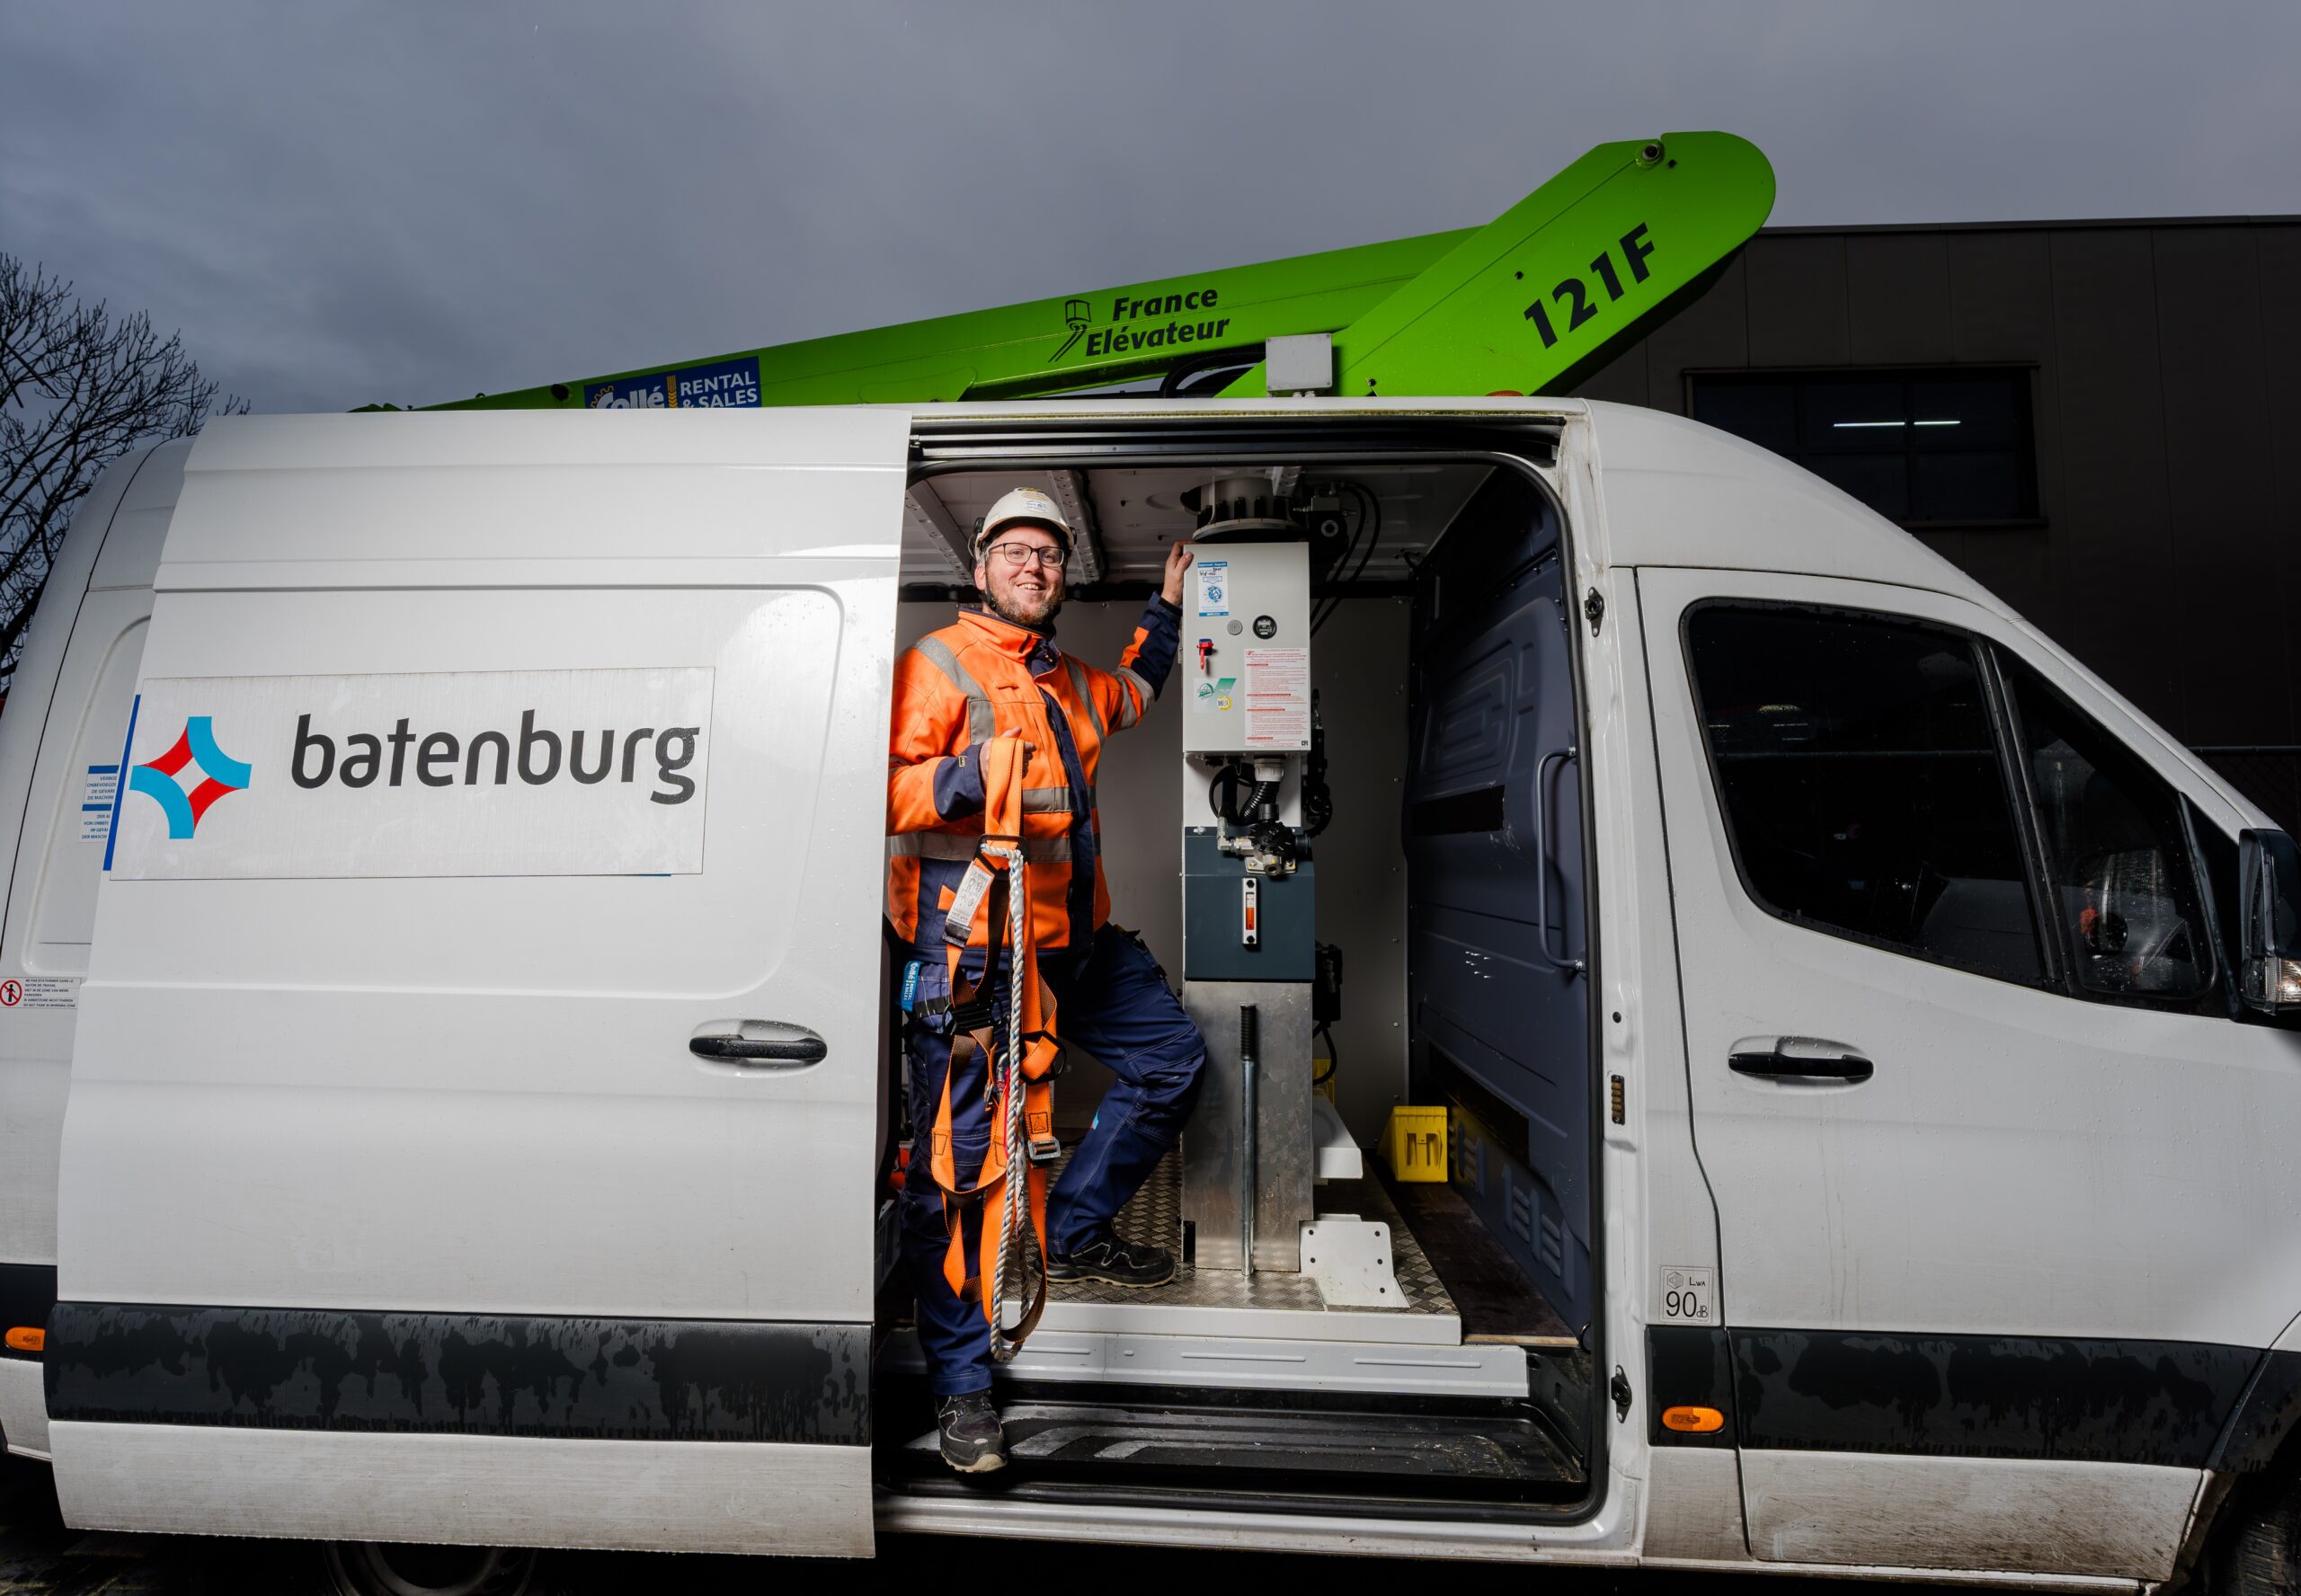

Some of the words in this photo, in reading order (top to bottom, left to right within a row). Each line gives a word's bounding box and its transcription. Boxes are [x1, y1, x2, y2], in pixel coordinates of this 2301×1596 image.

[1524, 221, 1655, 350] 121F
[1112, 288, 1219, 322] France
[1085, 318, 1230, 357] Elévateur
[680, 371, 757, 396] RENTAL
[682, 398, 695, 408] &
[698, 387, 758, 408] SALES
[291, 709, 701, 805] batenburg
